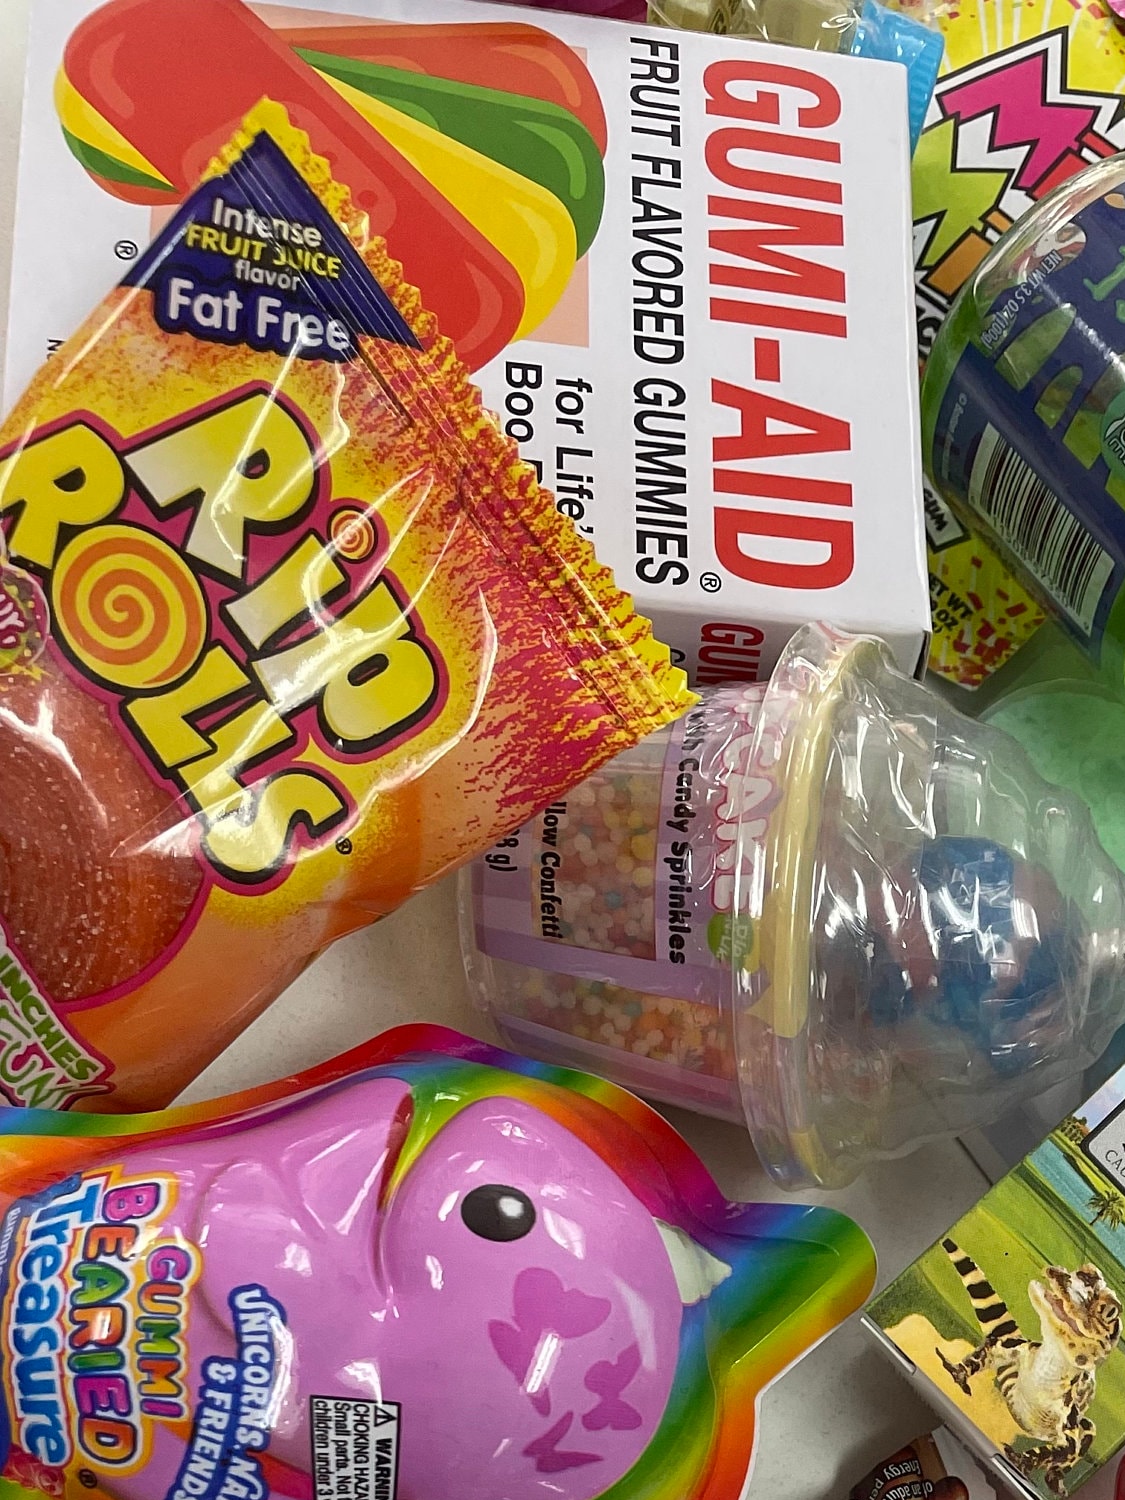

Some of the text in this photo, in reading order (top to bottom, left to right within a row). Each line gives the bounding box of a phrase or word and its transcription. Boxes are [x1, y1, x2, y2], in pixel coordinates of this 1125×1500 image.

[186, 223, 266, 263] FRUIT
[210, 197, 323, 247] Intense
[1038, 249, 1064, 275] NET
[166, 276, 351, 352] Fat Free
[234, 260, 301, 291] flavor
[629, 37, 690, 586] FRUIT FLAVORED GUMMIES
[702, 59, 854, 590] GUMI-AID
[506, 360, 542, 442] Boo
[555, 376, 593, 535] for Life'
[0, 420, 350, 888] ROLLS
[542, 844, 563, 942] Confetti
[667, 756, 700, 966] Candy Sprinkles
[12, 1183, 102, 1465] Treasure
[70, 1181, 161, 1465] BEARIED
[135, 1246, 194, 1418] GUMMI
[208, 1362, 237, 1384] &
[314, 1400, 330, 1485] children under
[334, 1402, 350, 1437] Small
[353, 1403, 370, 1463] CHOKING
